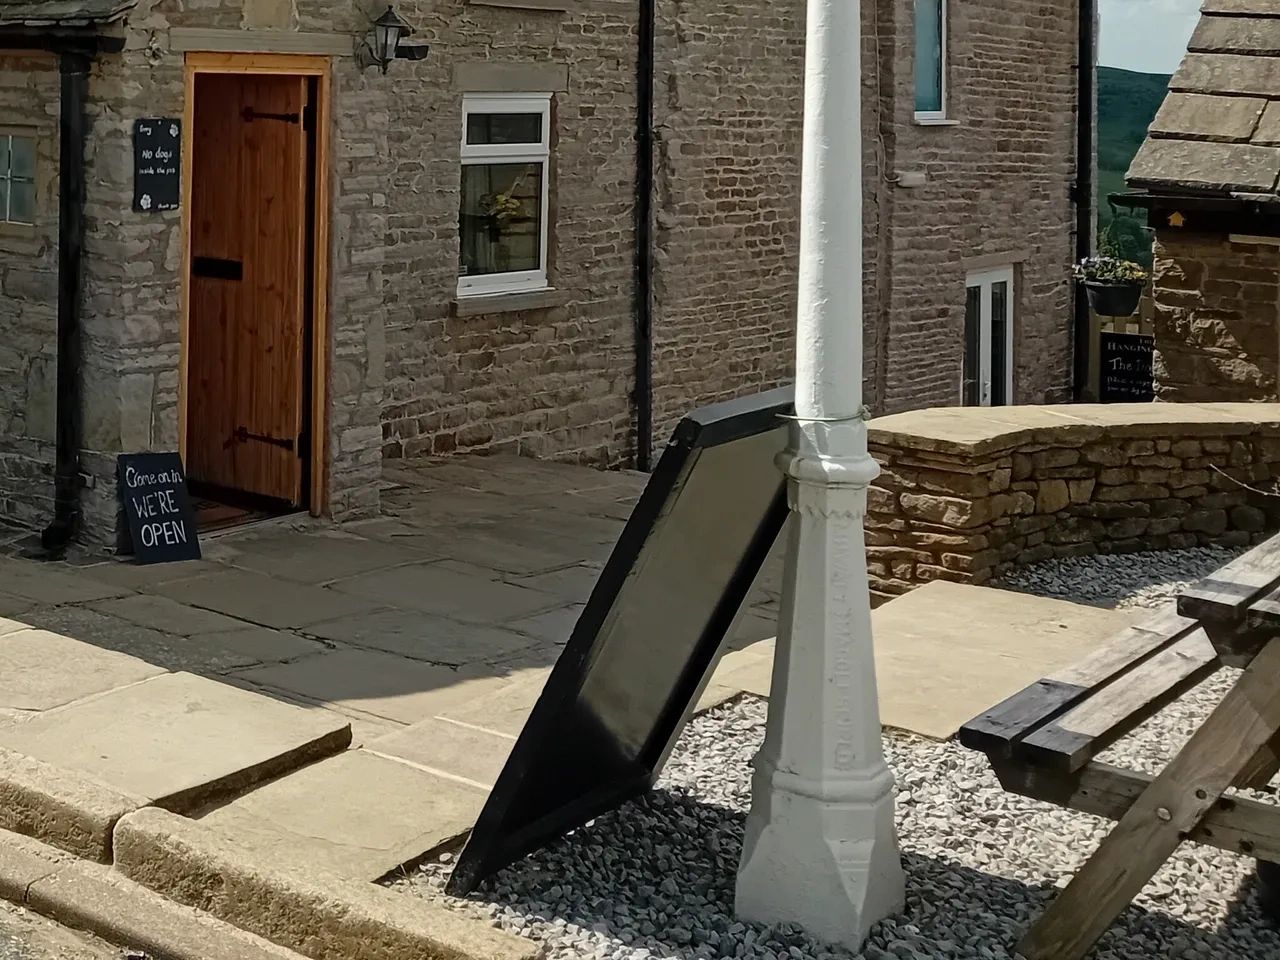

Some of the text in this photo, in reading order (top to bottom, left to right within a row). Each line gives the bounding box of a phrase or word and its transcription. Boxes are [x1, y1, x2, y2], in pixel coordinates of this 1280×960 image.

[155, 146, 172, 162] dogs
[1107, 342, 1152, 352] HANGIN
[1107, 356, 1133, 371] The
[126, 466, 183, 488] Come on in
[132, 490, 179, 518] WE'RE
[141, 519, 187, 547] OPEN
